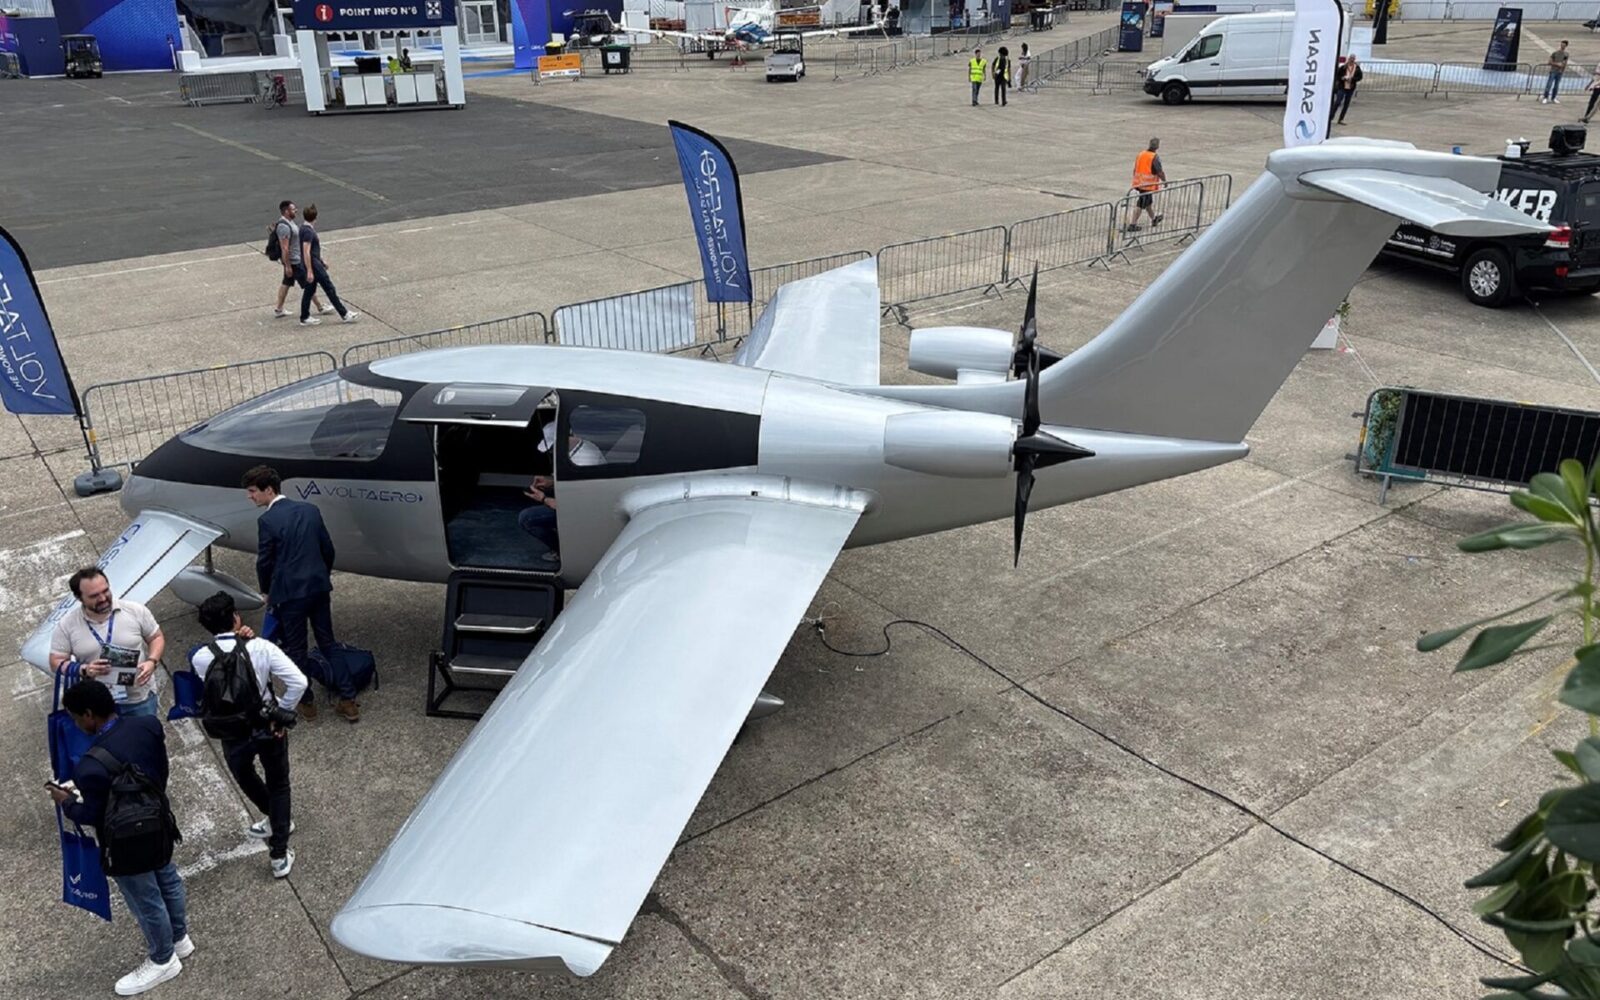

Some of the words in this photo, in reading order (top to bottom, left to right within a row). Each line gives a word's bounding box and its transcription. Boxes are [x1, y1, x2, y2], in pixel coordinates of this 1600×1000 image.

[339, 7, 371, 16] POINT
[373, 6, 398, 16] INFO
[1493, 188, 1558, 223] KER
[324, 486, 422, 503] VOLTAERO
[96, 524, 141, 570] CASS
